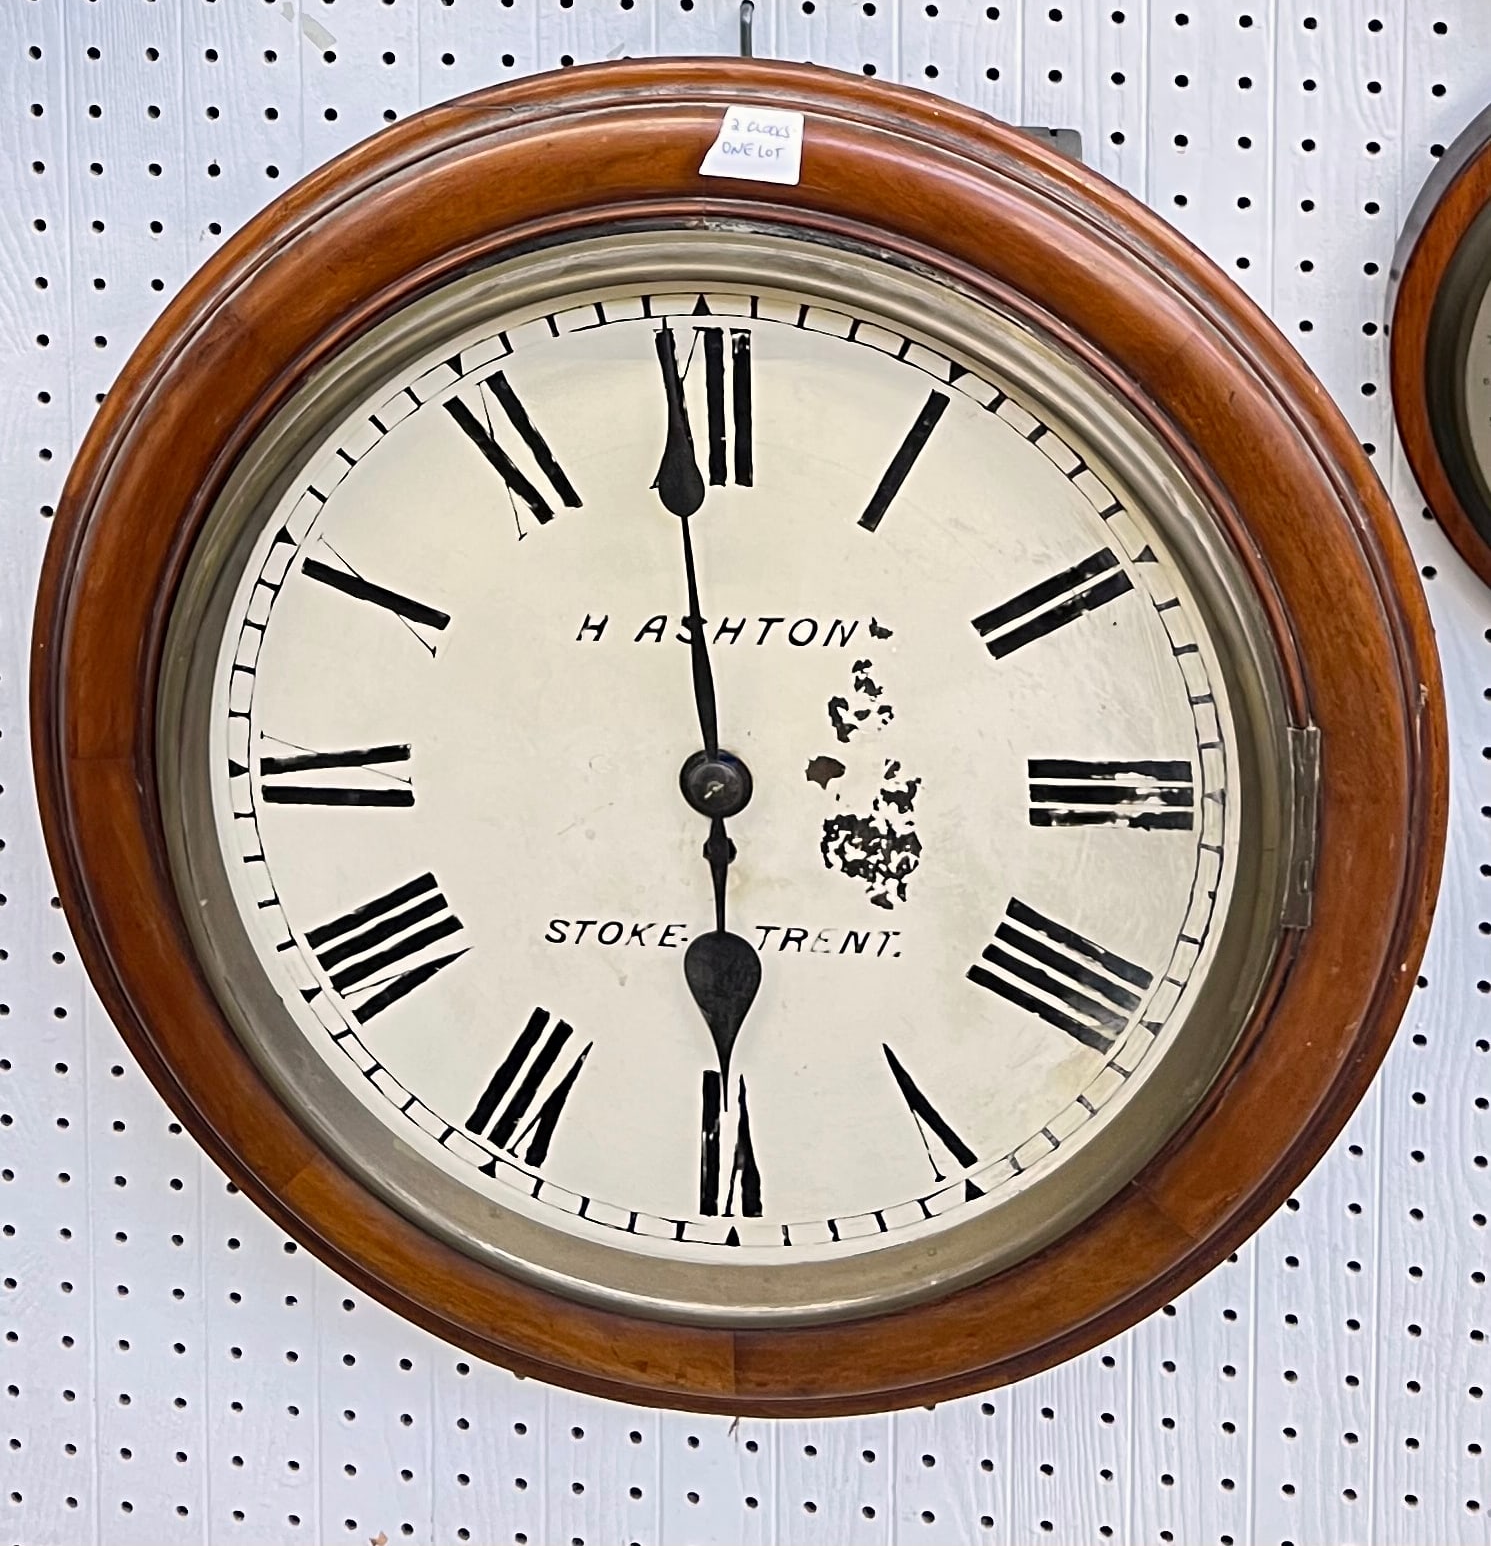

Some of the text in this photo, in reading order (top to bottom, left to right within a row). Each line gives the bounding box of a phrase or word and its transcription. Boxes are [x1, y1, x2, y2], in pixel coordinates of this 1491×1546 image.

[722, 141, 786, 160] ONE LOT
[442, 369, 583, 541] XI
[971, 547, 1134, 660] II
[1028, 758, 1194, 831] III
[966, 896, 1154, 1055] IIII
